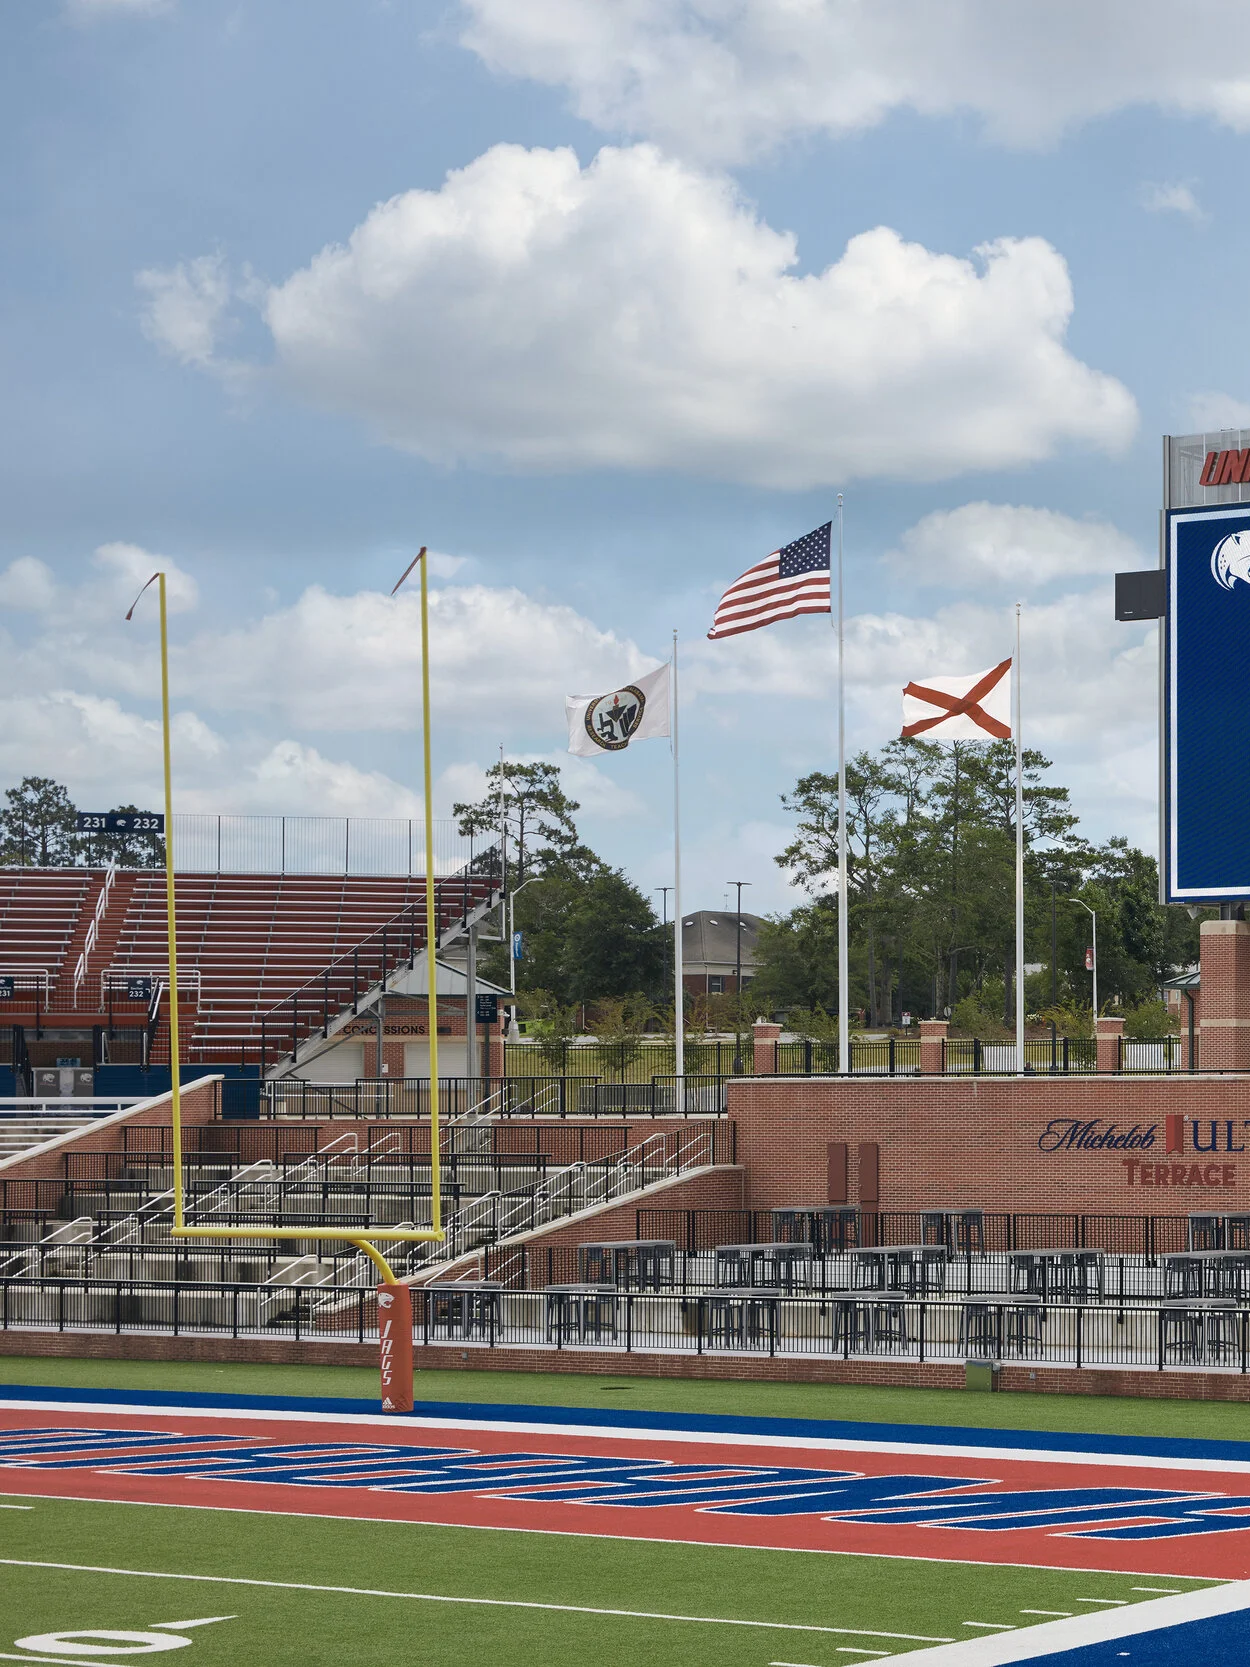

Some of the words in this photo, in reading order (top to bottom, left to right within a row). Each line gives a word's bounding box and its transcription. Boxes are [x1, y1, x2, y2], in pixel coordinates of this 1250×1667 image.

[83, 817, 106, 828] 231
[133, 818, 159, 829] 232
[343, 1025, 425, 1035] CONCSSIONS
[1038, 1118, 1159, 1151] Michelob
[1122, 1158, 1236, 1187] TERRACE
[380, 1320, 393, 1386] JAGS
